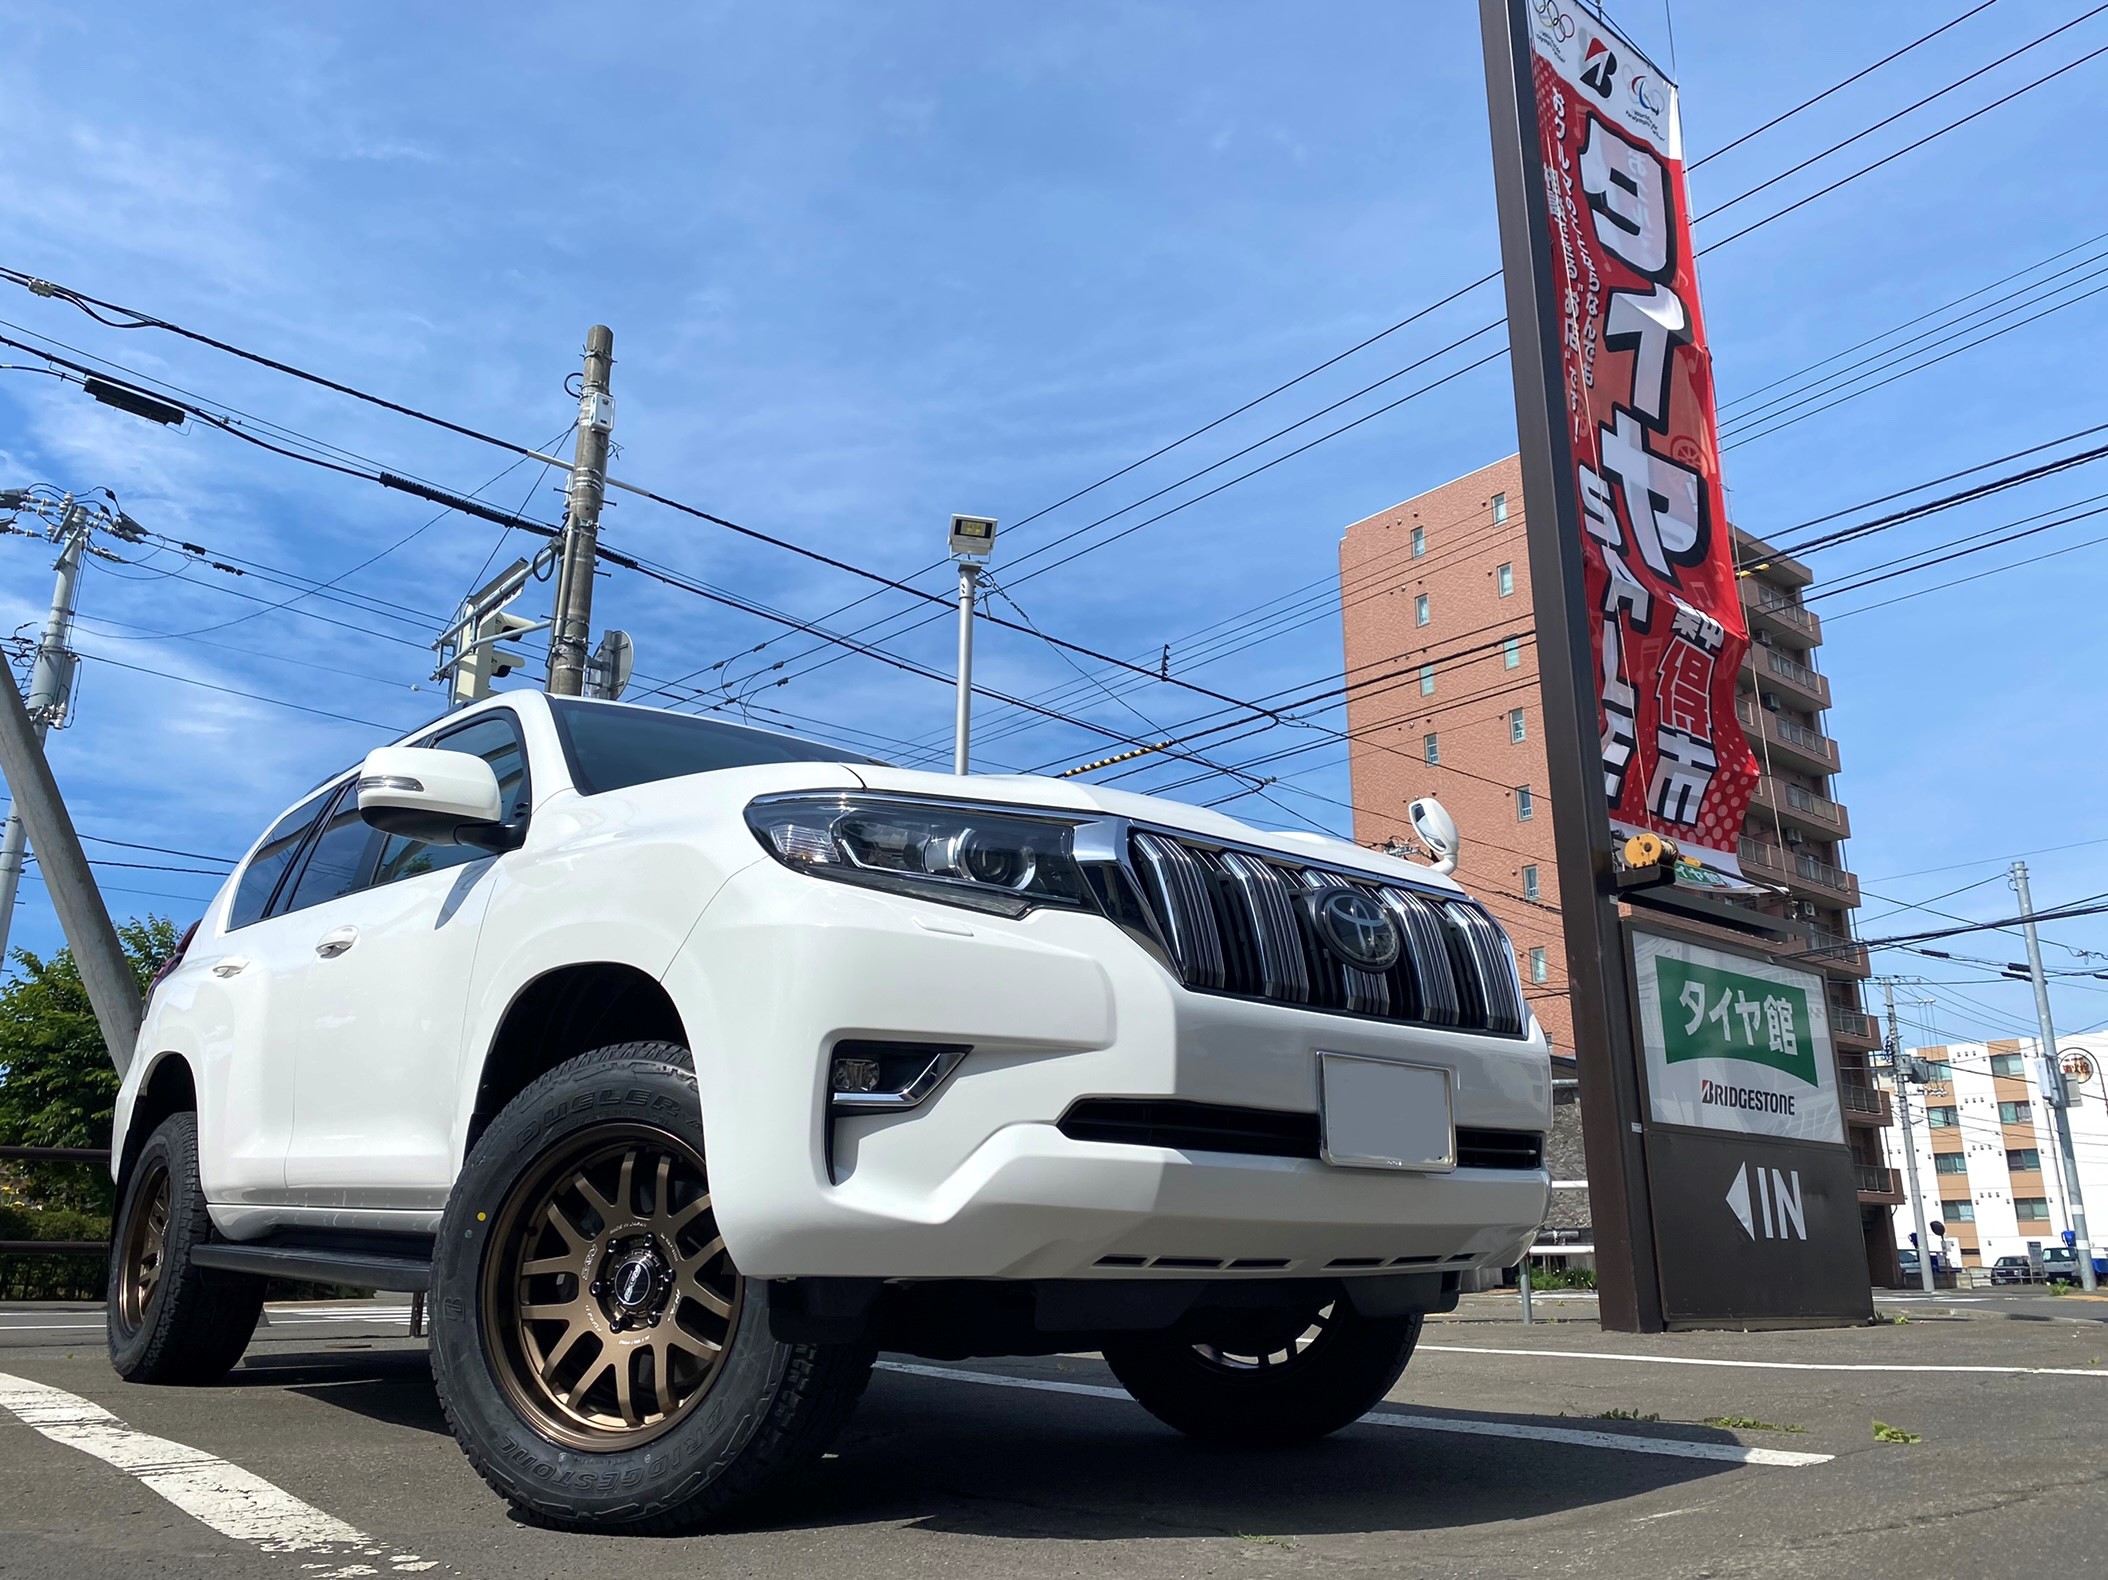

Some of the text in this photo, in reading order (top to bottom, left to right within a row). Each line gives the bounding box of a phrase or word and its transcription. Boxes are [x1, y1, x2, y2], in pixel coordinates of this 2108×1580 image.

[1579, 116, 1698, 577] タイヤ
[1679, 980, 1798, 1056] タイヤ館
[515, 1088, 682, 1153] DUELER
[1701, 1079, 1795, 1116] BRIDGESTONE
[1757, 1167, 1807, 1241] IN
